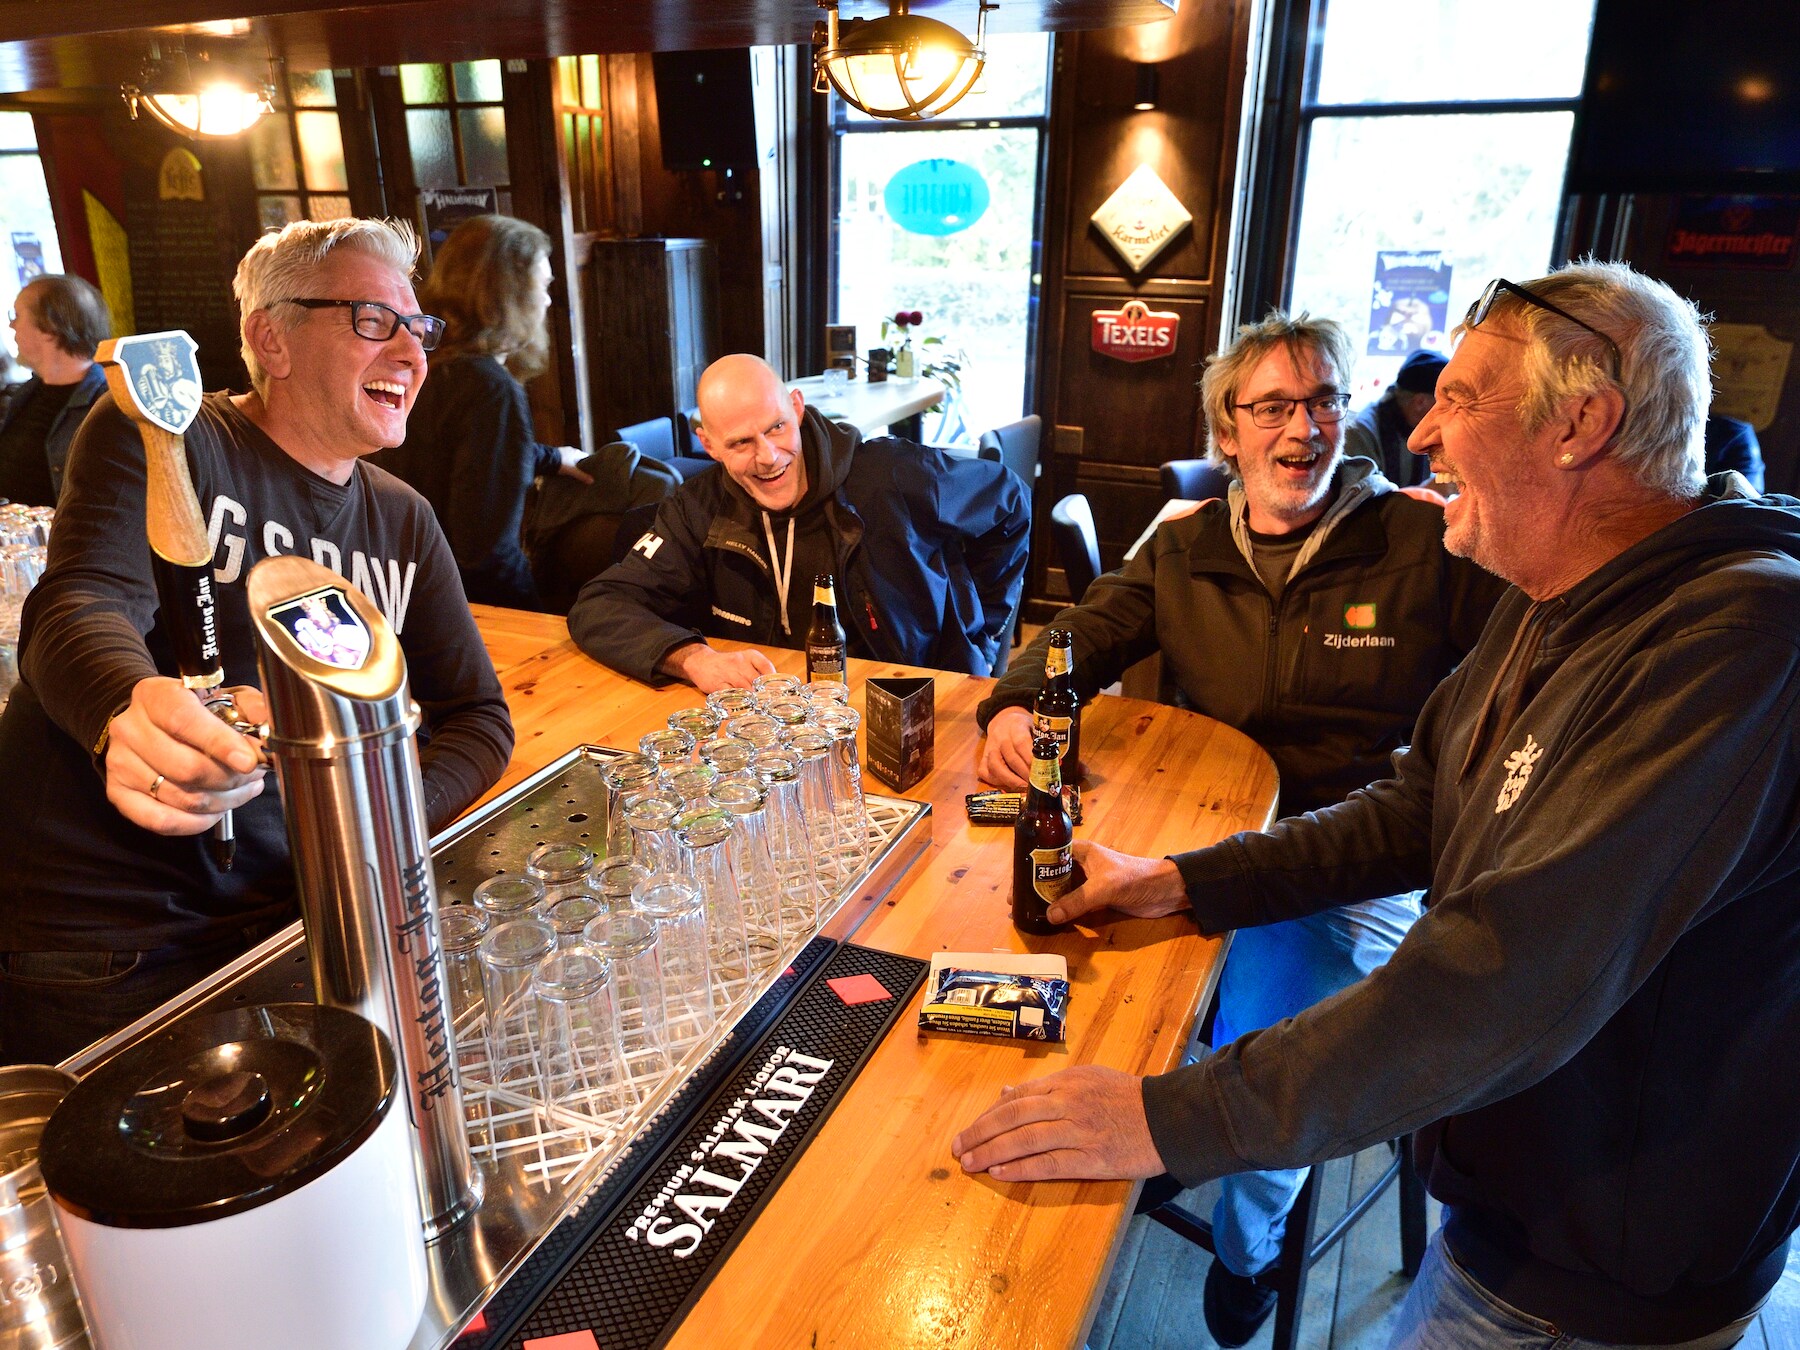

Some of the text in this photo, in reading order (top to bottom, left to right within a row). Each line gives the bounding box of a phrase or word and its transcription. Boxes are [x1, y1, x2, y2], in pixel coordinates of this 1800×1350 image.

[1097, 317, 1171, 347] TEXELS
[725, 540, 768, 569] HELLY HANSEN
[196, 576, 220, 660] Hertog Jan
[1323, 633, 1396, 650] Zijderlaan
[396, 856, 459, 1111] Hertog Jan
[625, 1163, 694, 1242] PREMIUM
[690, 1097, 749, 1162] SALMIAK
[744, 1045, 791, 1096] LIQUOR
[646, 1049, 835, 1259] SALMARI
